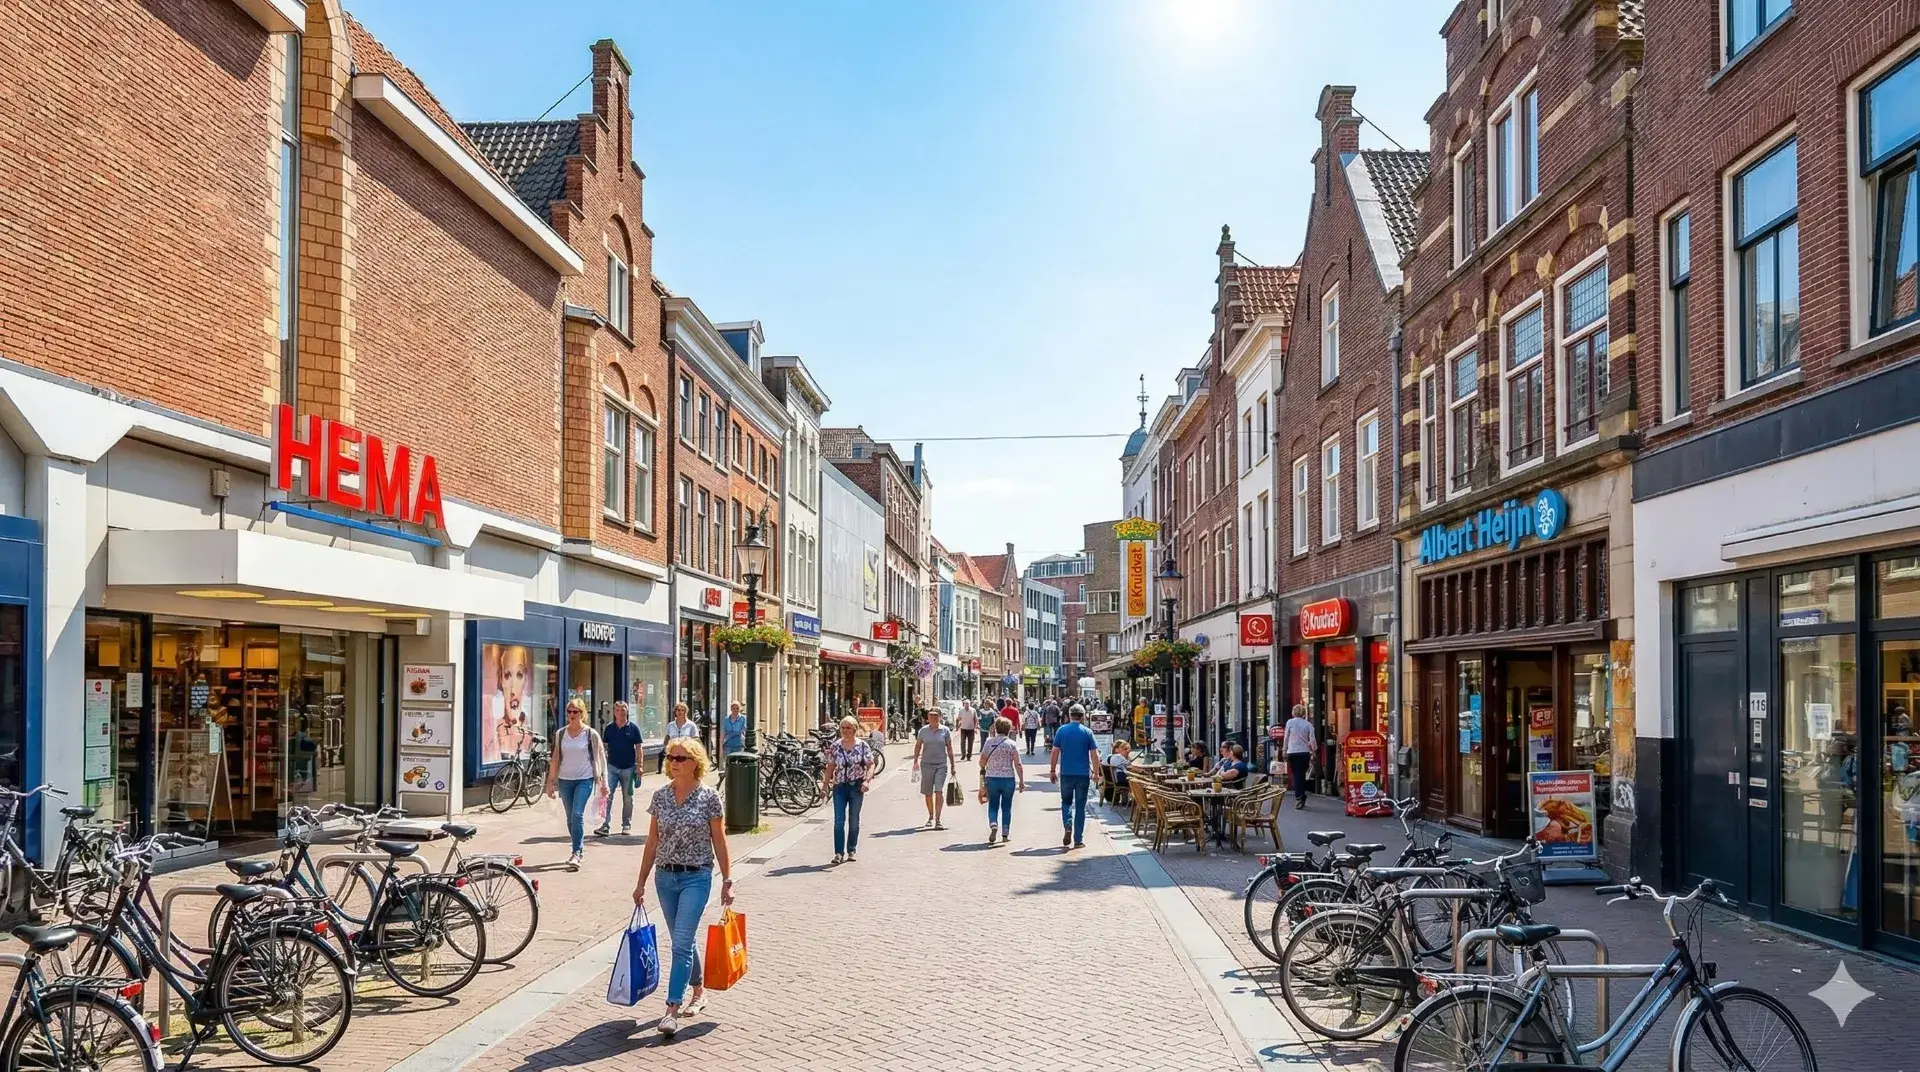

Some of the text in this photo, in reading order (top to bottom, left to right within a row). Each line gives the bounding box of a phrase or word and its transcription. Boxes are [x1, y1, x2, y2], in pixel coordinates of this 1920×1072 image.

[271, 402, 446, 531] HEMA
[1420, 498, 1532, 565] Albert Heijn
[1131, 547, 1143, 598] Kruidvat
